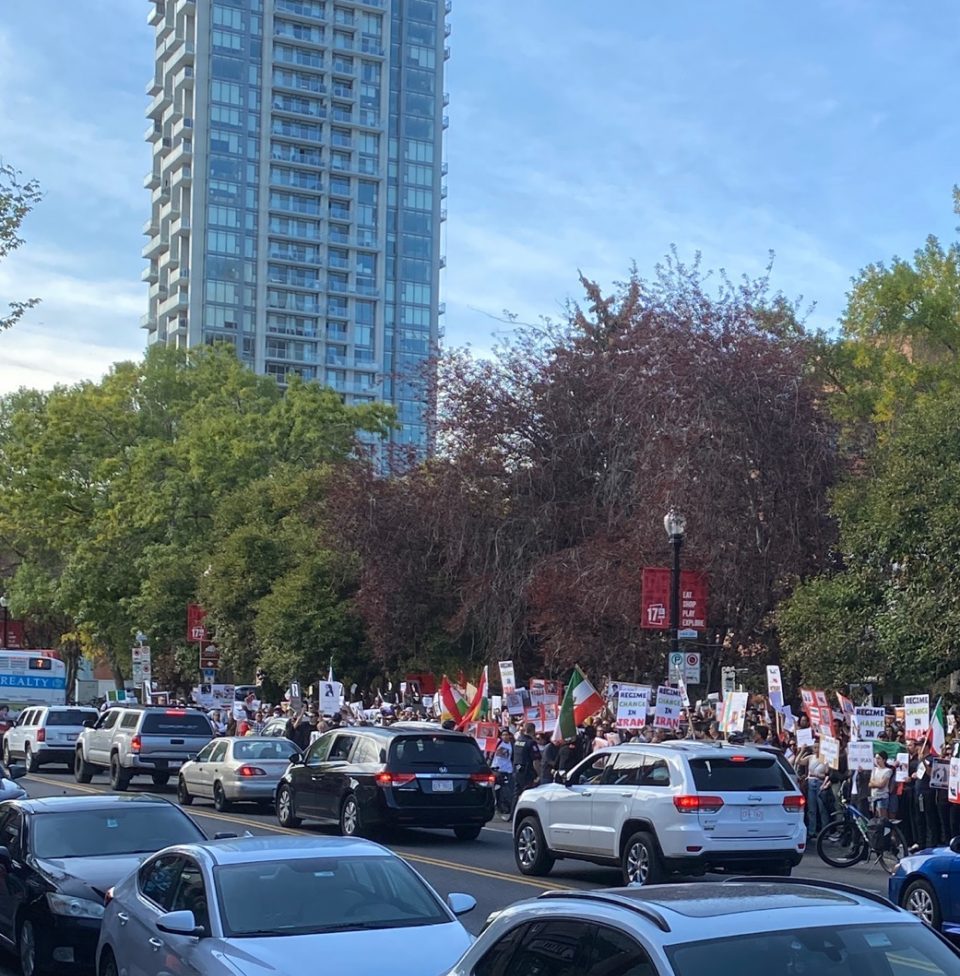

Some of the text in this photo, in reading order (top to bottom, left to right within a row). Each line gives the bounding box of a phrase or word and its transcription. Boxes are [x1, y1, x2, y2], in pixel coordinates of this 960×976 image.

[682, 591, 693, 599] EAT
[0, 676, 49, 687] REALTY
[616, 718, 645, 727] IRAN
[655, 716, 679, 728] IRAN
[865, 730, 875, 738] IN
